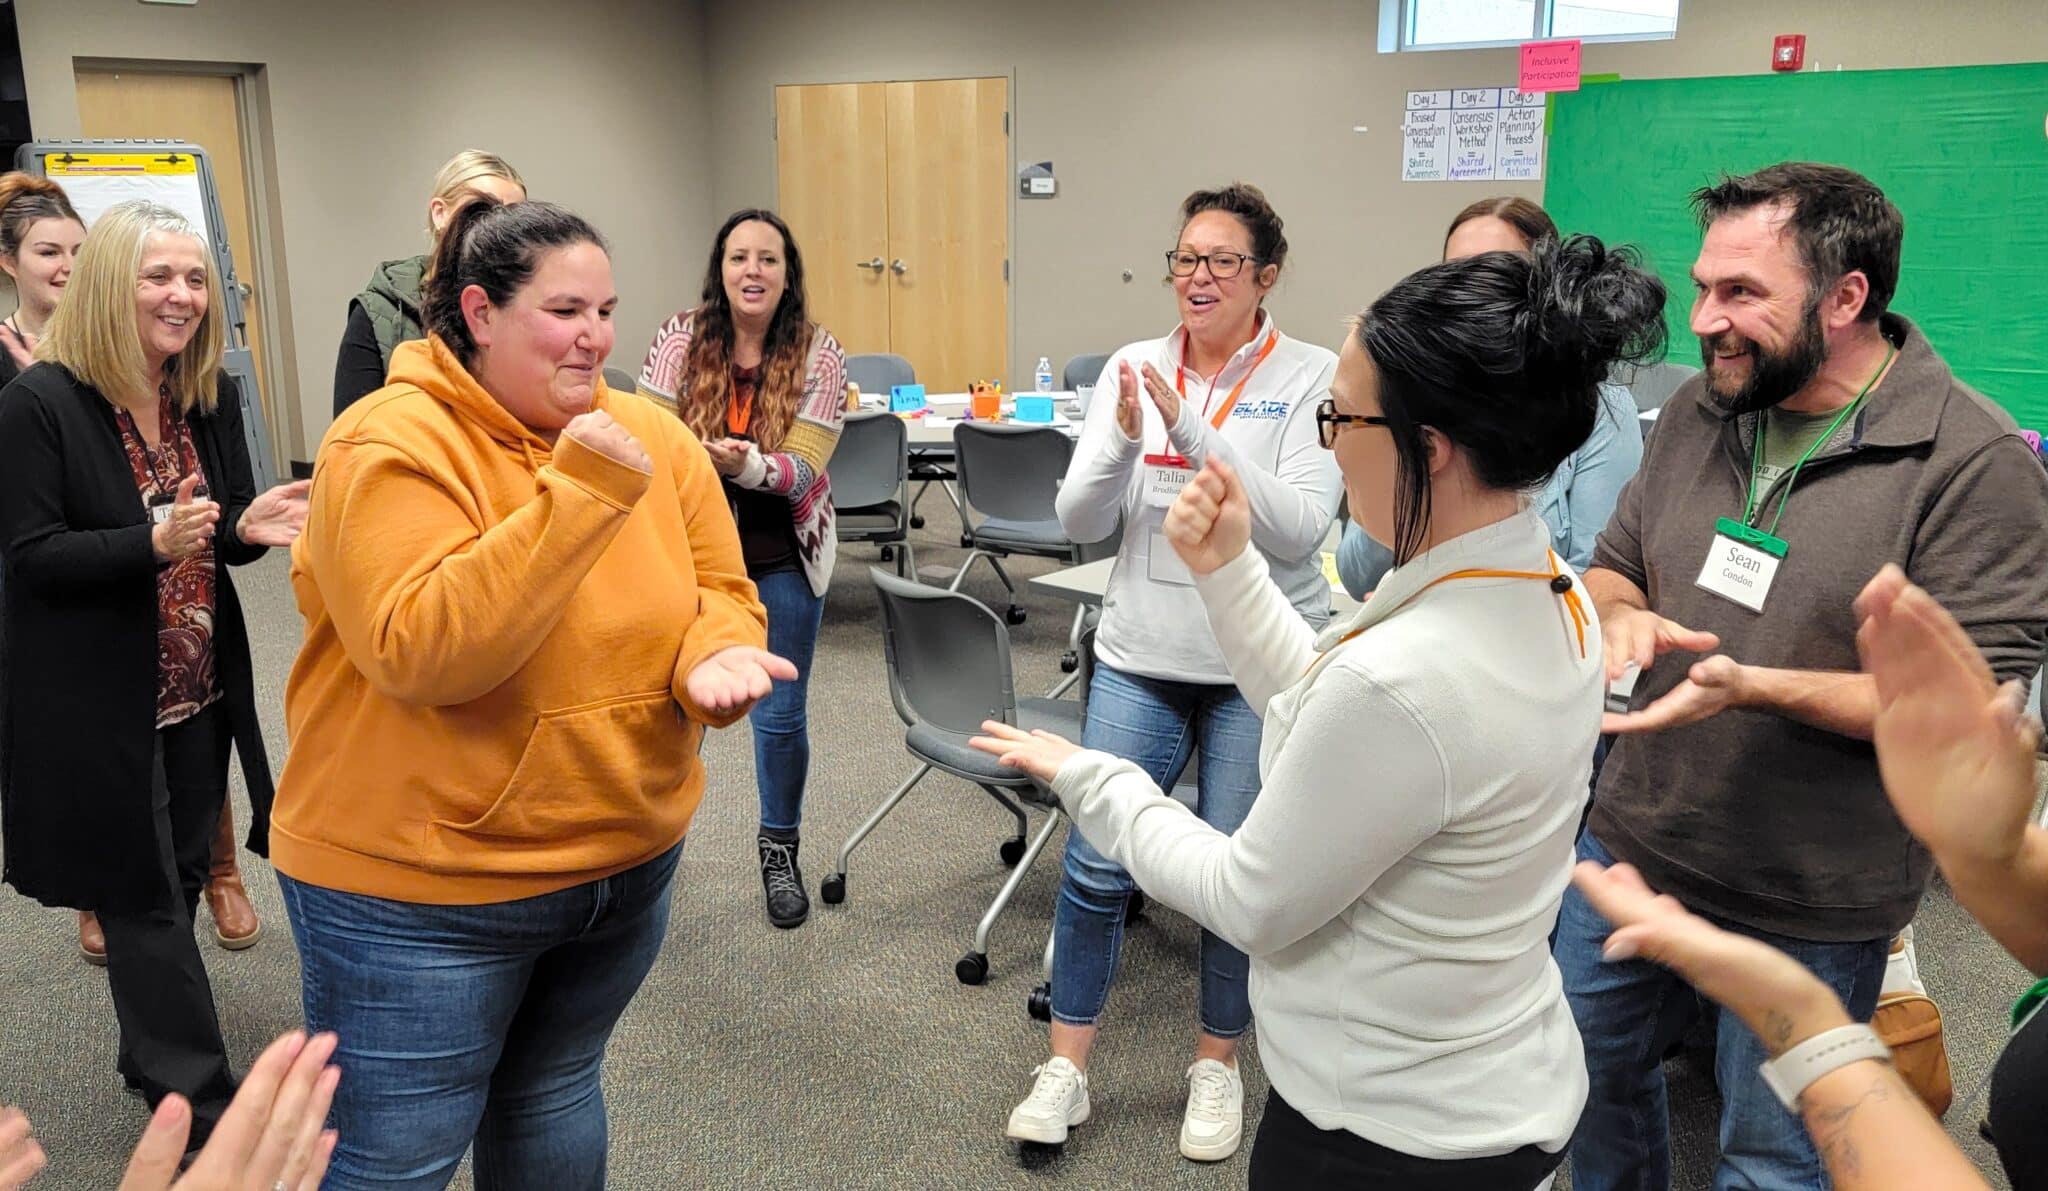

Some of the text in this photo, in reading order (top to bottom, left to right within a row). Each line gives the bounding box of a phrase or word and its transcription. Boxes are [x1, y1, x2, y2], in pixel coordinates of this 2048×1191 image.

[1531, 56, 1569, 66] Inclusive
[1521, 71, 1578, 81] Participation
[1413, 93, 1439, 107] Day 1
[1461, 90, 1487, 106] Day 2
[1508, 90, 1535, 106] Day 3
[1411, 111, 1437, 124] Focused
[1452, 111, 1494, 124] Consensus
[1507, 109, 1536, 121] Action
[1405, 123, 1446, 137] Conversation
[1455, 123, 1493, 137] Workshop
[1499, 119, 1538, 134] Planning
[1412, 136, 1436, 148] Method
[1459, 135, 1487, 148] Method
[1506, 134, 1534, 145] Process
[1408, 158, 1434, 168] Shared
[1457, 154, 1485, 167] Shared
[1500, 152, 1538, 166] Committed
[1449, 165, 1493, 177] Agreement
[1506, 167, 1531, 177] Action
[1234, 400, 1290, 414] BLADE
[1156, 470, 1186, 484] Talia
[1727, 547, 1762, 574] Sean
[1722, 568, 1753, 589] Condon
